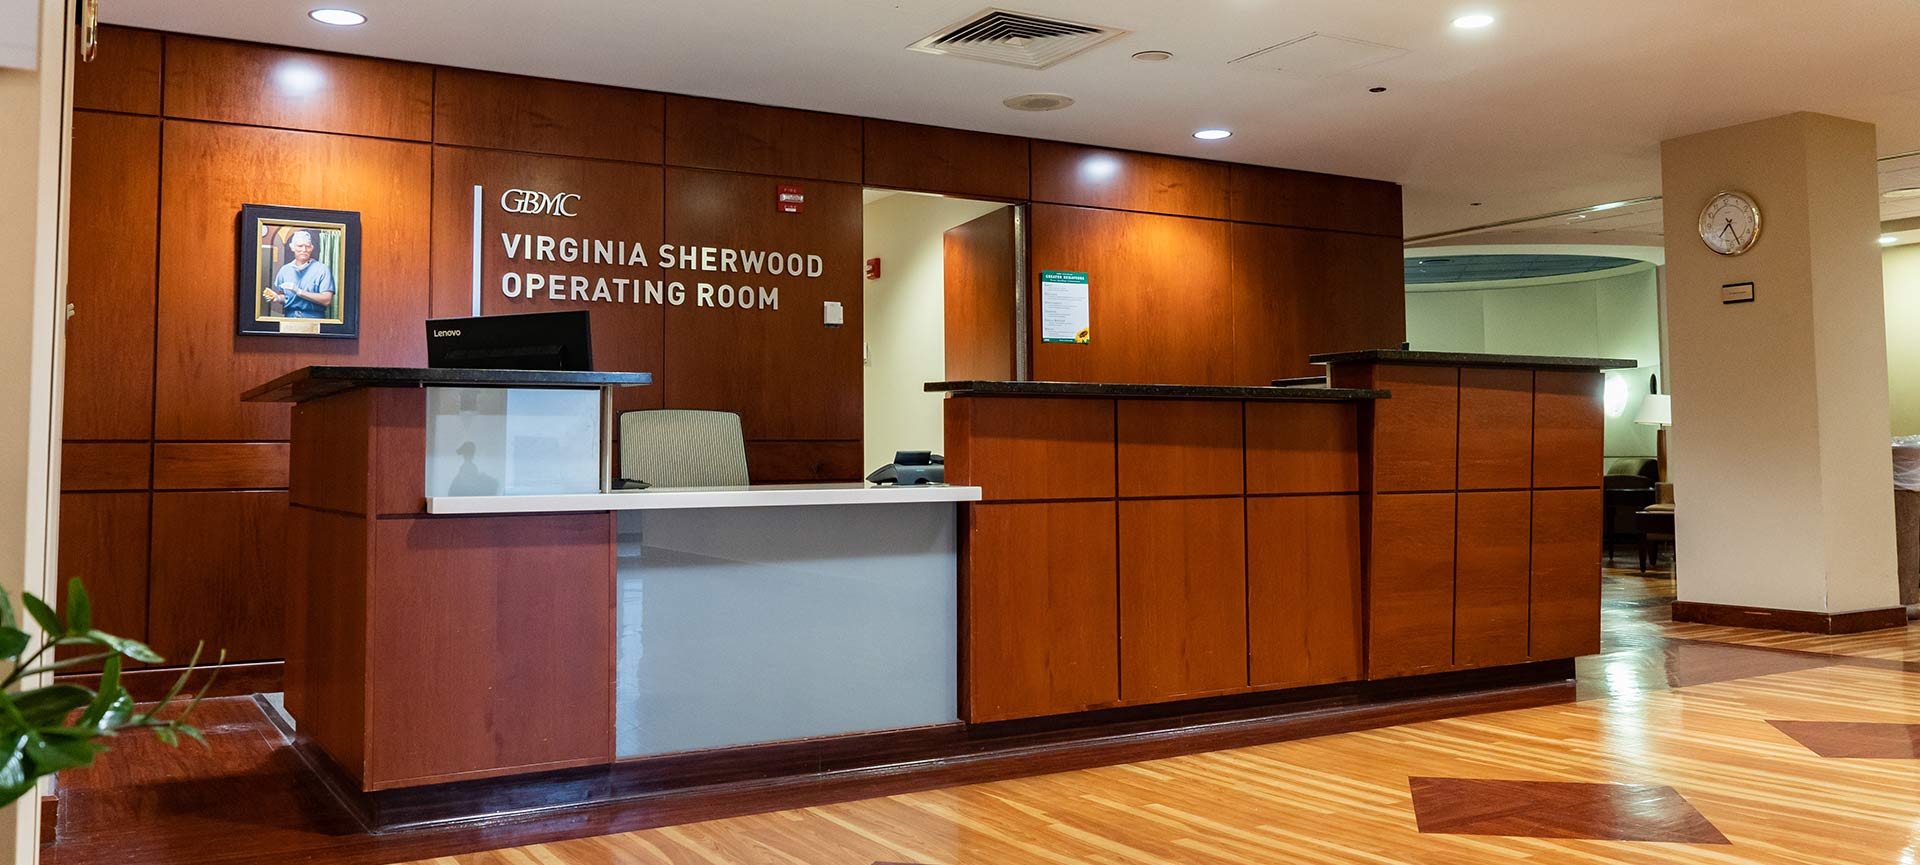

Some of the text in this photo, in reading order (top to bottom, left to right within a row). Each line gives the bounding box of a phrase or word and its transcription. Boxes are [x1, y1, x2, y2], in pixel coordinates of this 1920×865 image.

[501, 189, 581, 217] GBMC
[501, 233, 823, 278] VIRGINIA SHERWOOD
[501, 272, 779, 310] OPERATING ROOM
[433, 329, 462, 338] Lenovo
